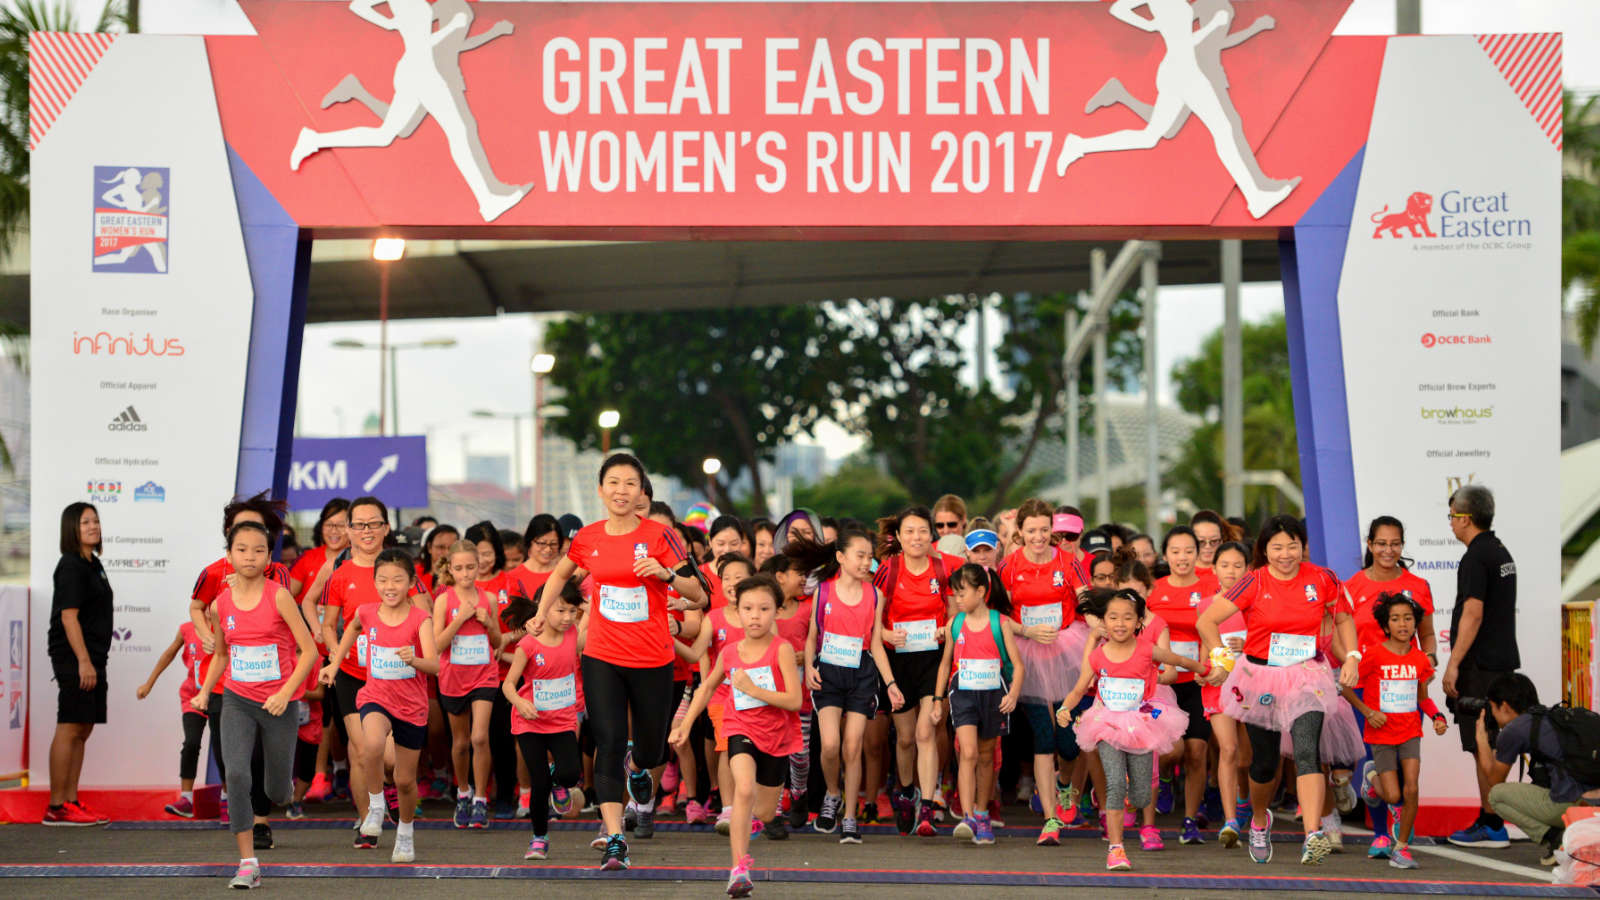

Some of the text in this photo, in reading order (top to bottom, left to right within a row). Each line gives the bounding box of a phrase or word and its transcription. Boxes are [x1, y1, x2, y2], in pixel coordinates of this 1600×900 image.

[541, 37, 1050, 115] GREAT EASTERN
[538, 131, 1053, 193] WOMEN'S RUN 2017
[1440, 190, 1509, 214] Great
[100, 215, 162, 226] GREAT EASTERN
[1441, 215, 1531, 238] Eastern
[100, 238, 118, 248] 2017
[1438, 334, 1491, 344] OCBC Bank
[1421, 405, 1493, 419] browhaus
[107, 422, 148, 432] adidas
[288, 459, 348, 491] KM
[91, 495, 118, 503] PLUS
[1380, 664, 1417, 679] TEAM
